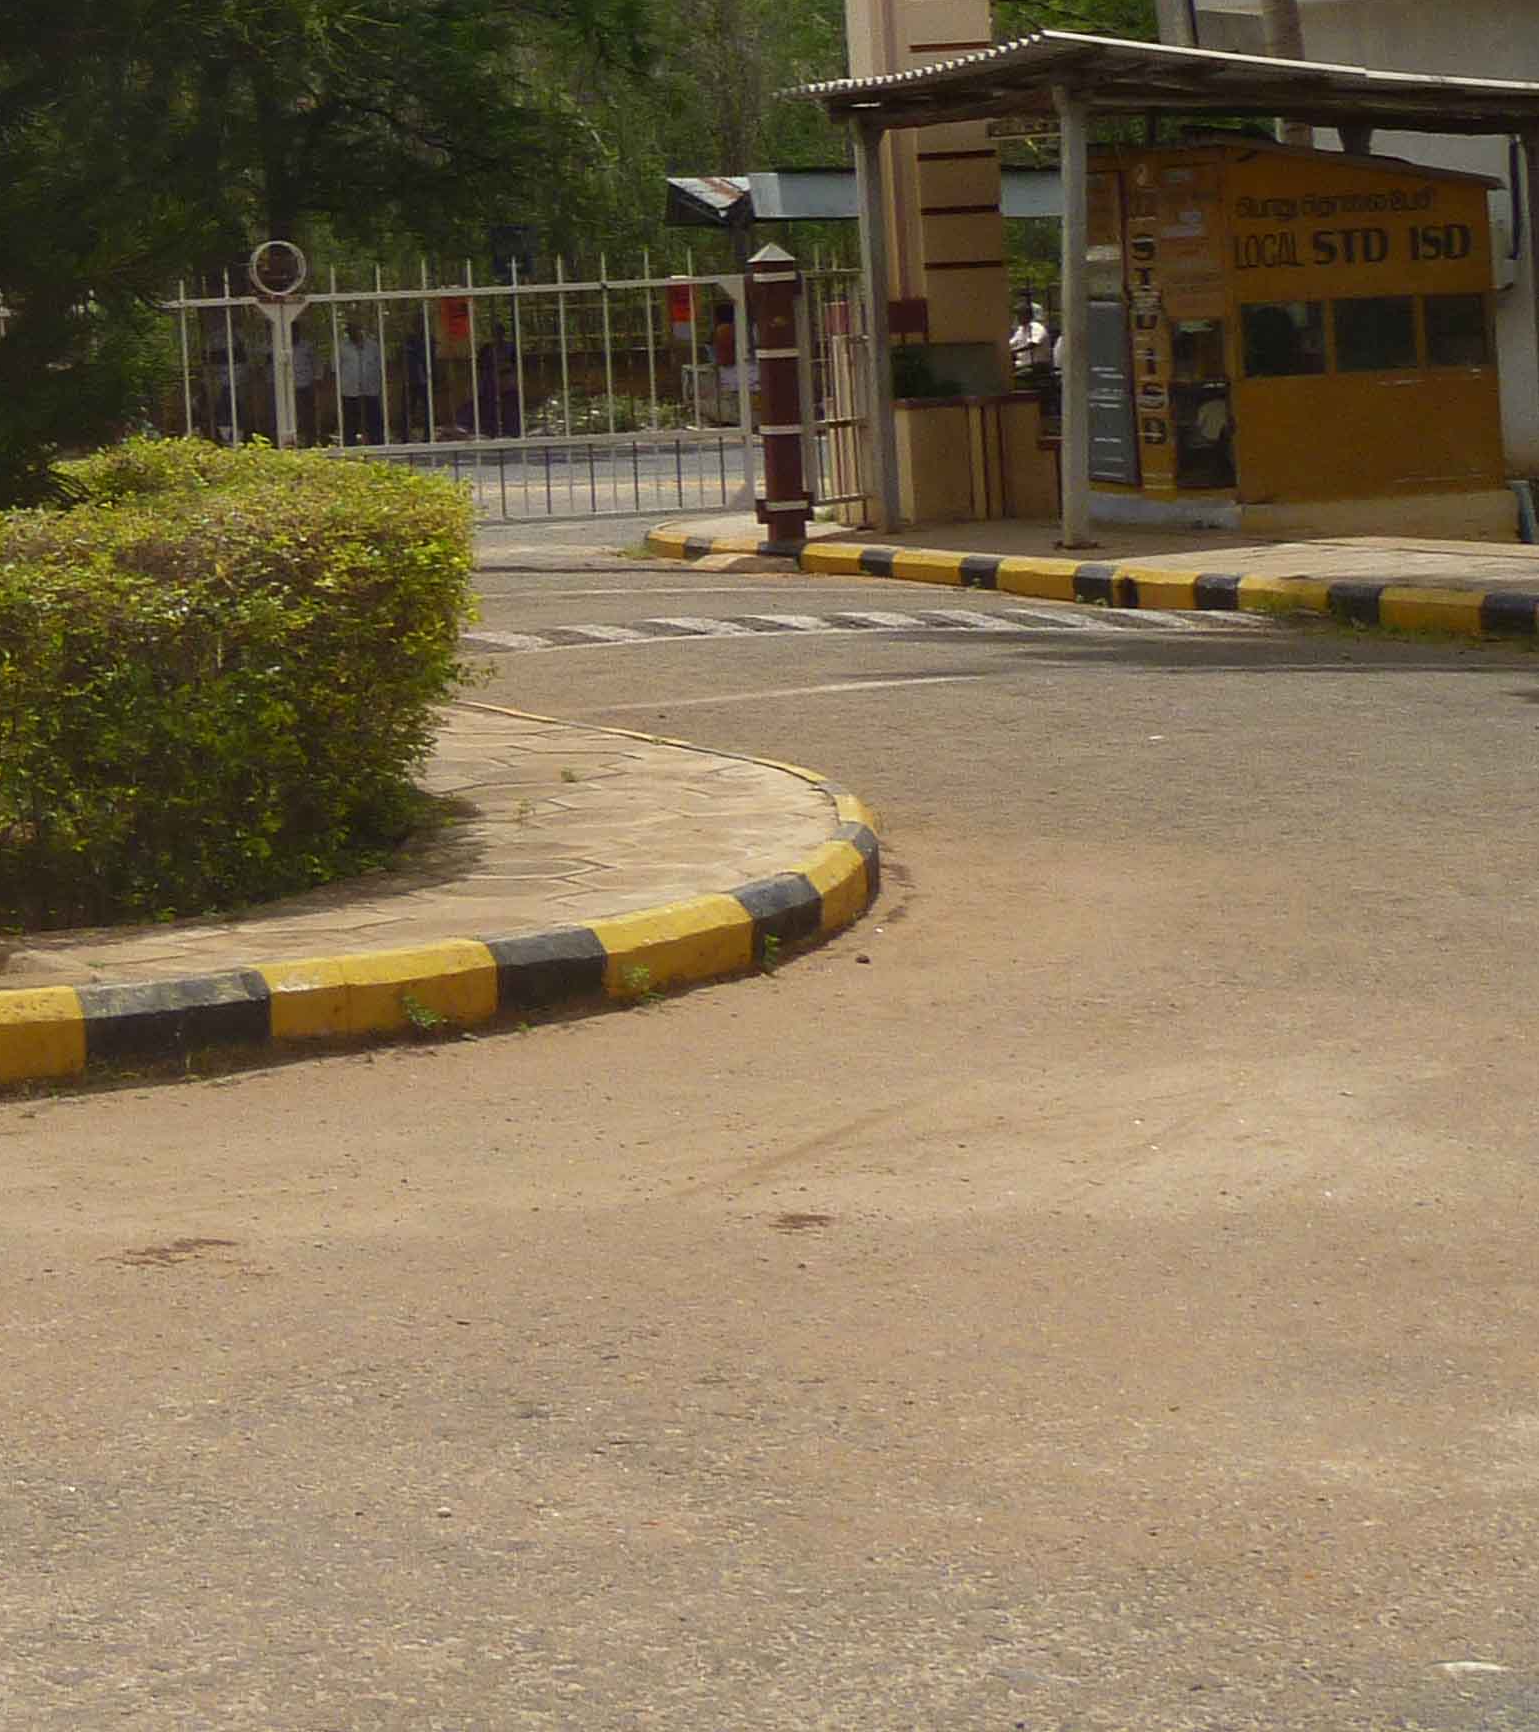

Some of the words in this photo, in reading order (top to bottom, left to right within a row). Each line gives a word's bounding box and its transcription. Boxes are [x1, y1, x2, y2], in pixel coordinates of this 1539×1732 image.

[1234, 231, 1303, 268] LOCAL
[1312, 227, 1389, 265] STD
[1409, 223, 1473, 261] ISD
